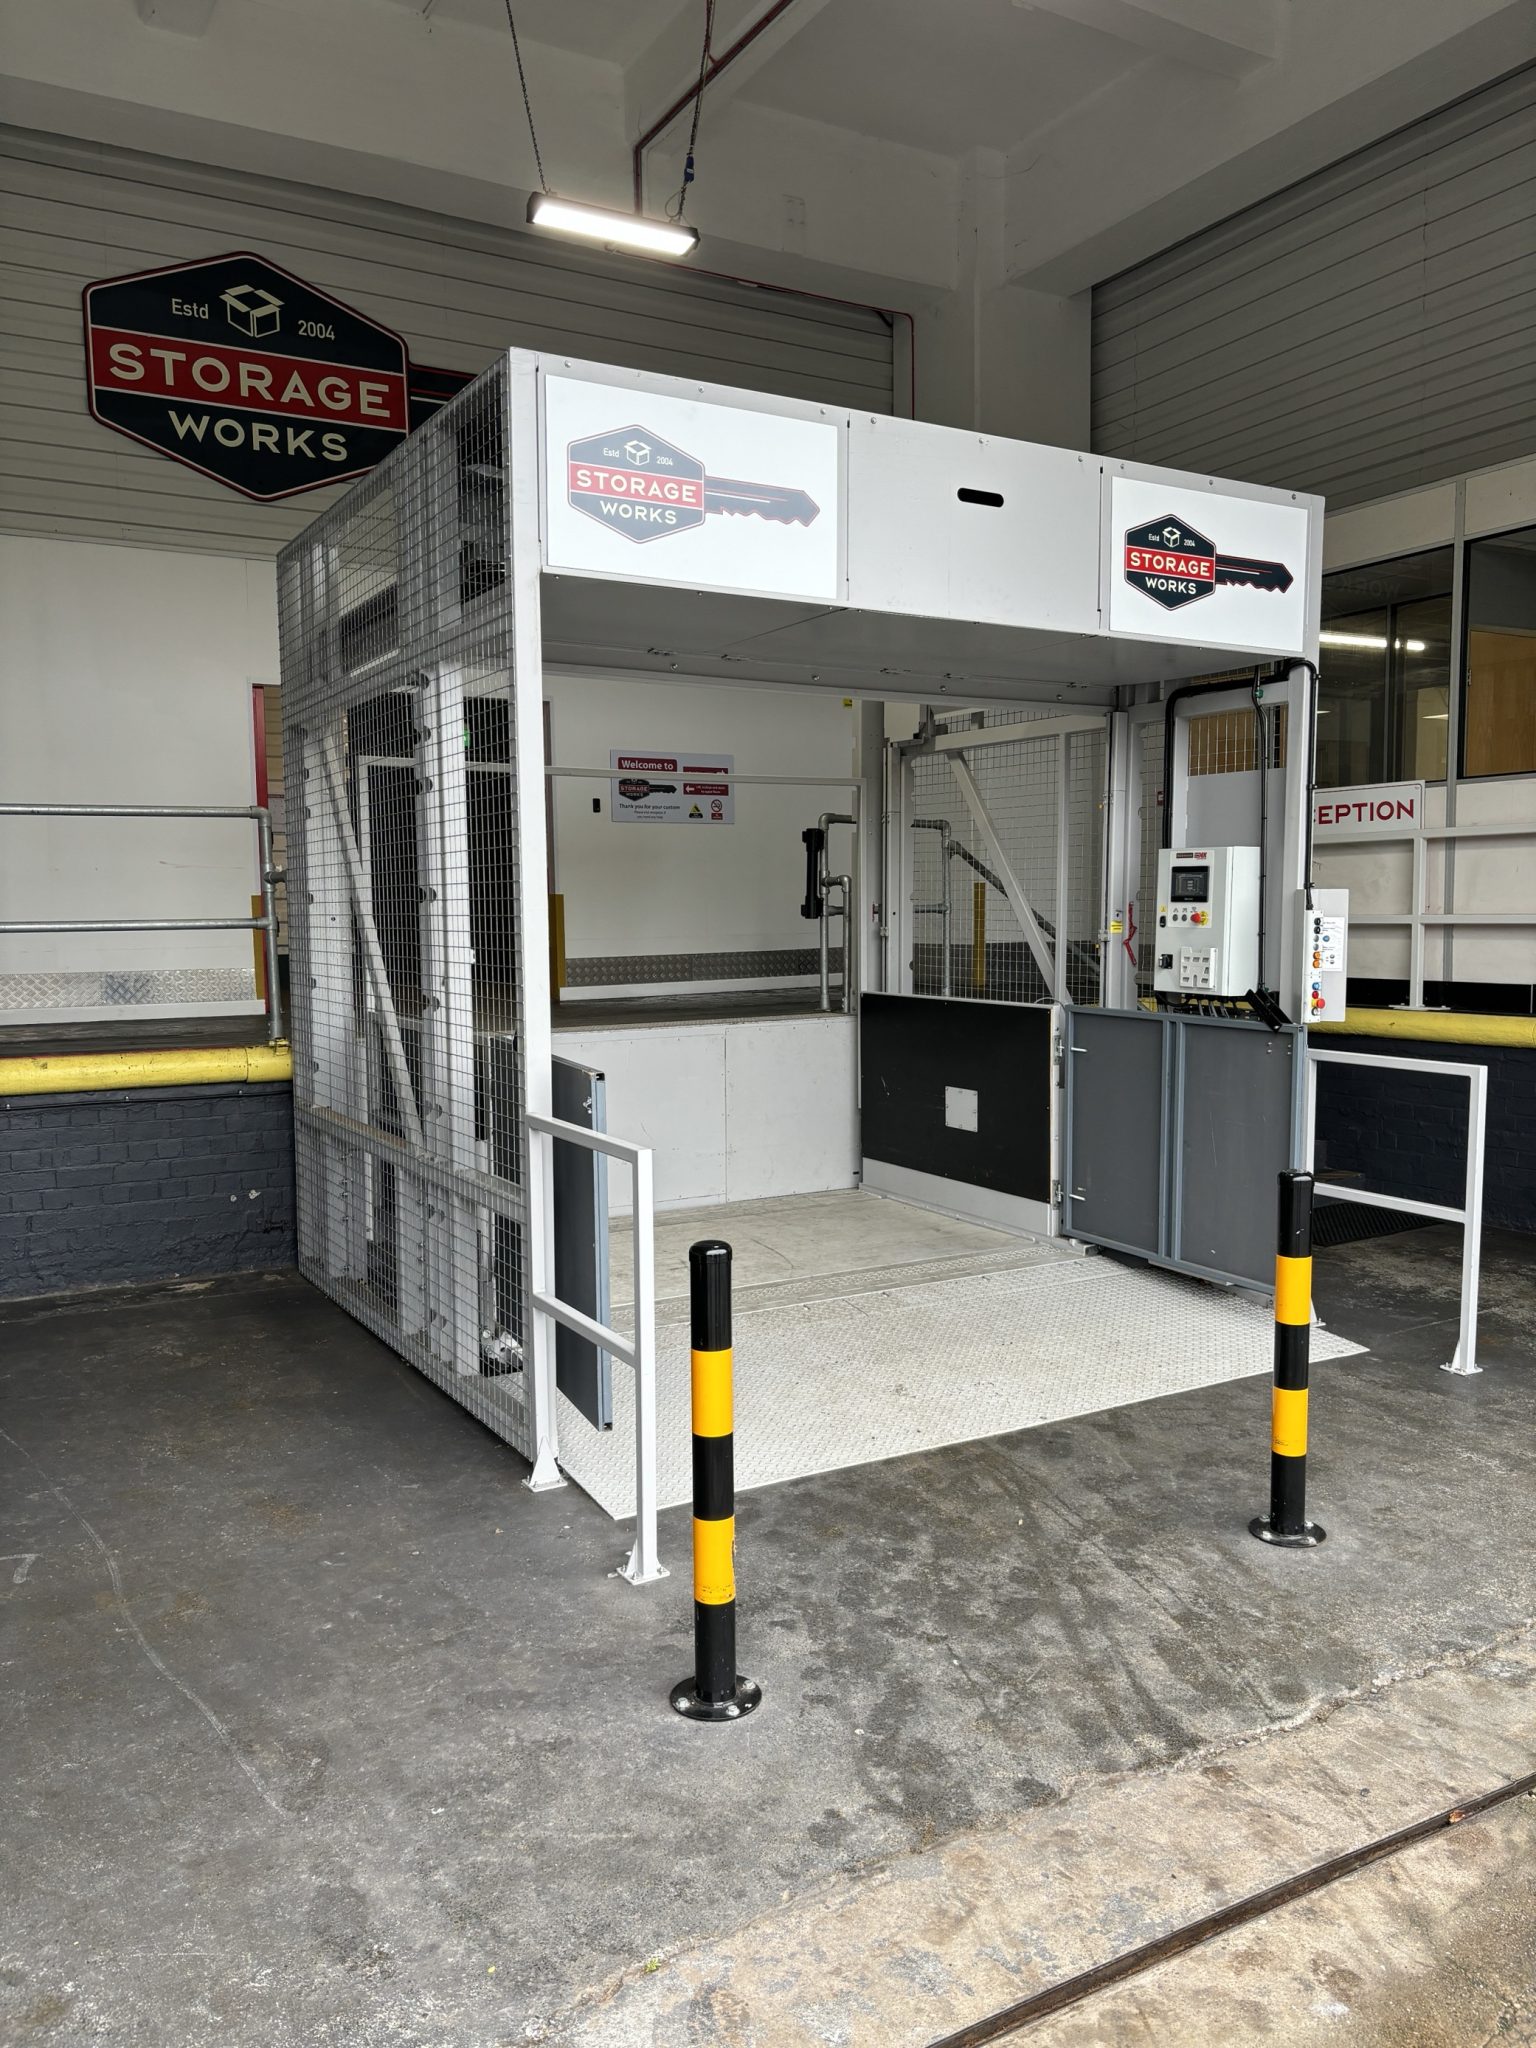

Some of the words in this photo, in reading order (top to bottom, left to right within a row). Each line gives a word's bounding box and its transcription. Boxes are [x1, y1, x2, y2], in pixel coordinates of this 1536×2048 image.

[171, 297, 209, 320] Estd
[298, 320, 336, 341] 2004
[109, 343, 391, 418] STORAGE
[168, 409, 348, 462] WORKS
[603, 447, 620, 459] Estd
[656, 455, 673, 467] 2004
[576, 469, 697, 503] STORAGE
[599, 500, 678, 525] WORKS
[1148, 533, 1160, 542] Estd
[1183, 538, 1196, 547] 2004
[1130, 552, 1211, 577] STORAGE
[1145, 576, 1197, 595] WORKS
[621, 759, 663, 770] Welcome
[664, 762, 674, 770] to
[1314, 799, 1414, 825] EPTION
